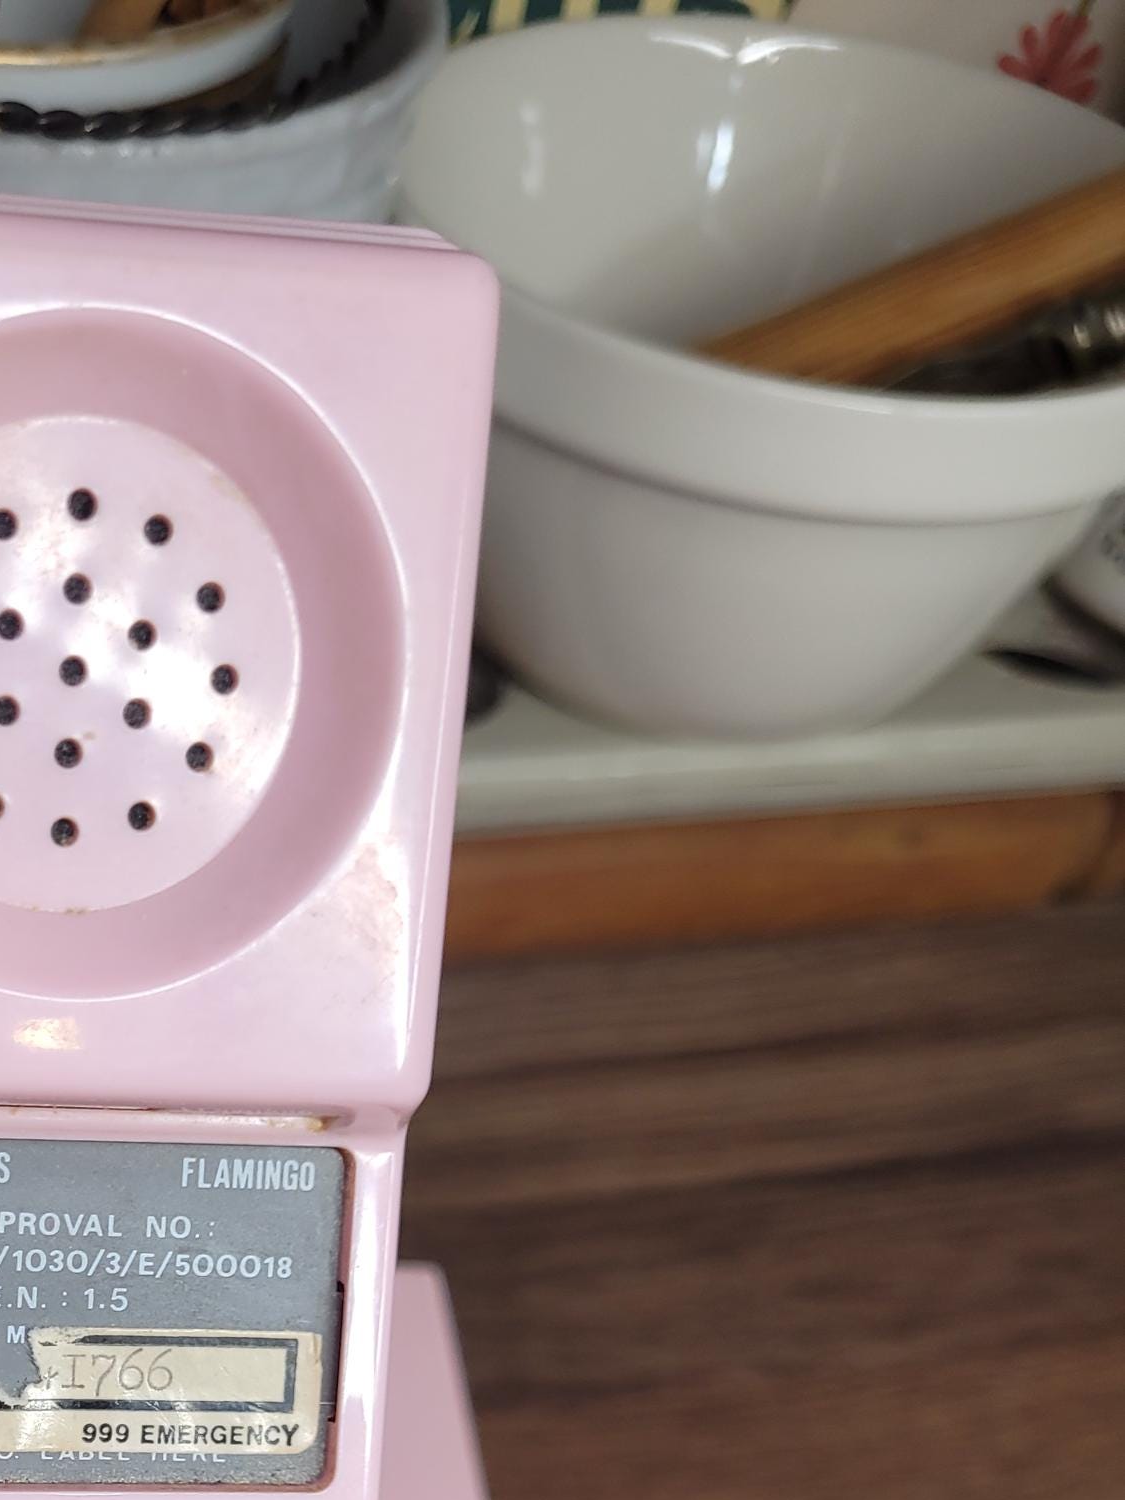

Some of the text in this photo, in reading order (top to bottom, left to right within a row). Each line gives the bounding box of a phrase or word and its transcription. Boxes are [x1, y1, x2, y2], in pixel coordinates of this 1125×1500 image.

[181, 1156, 316, 1192] FLAMINGO
[83, 1288, 129, 1312] 1.5
[81, 1422, 300, 1447] 999 EMERGENCY
